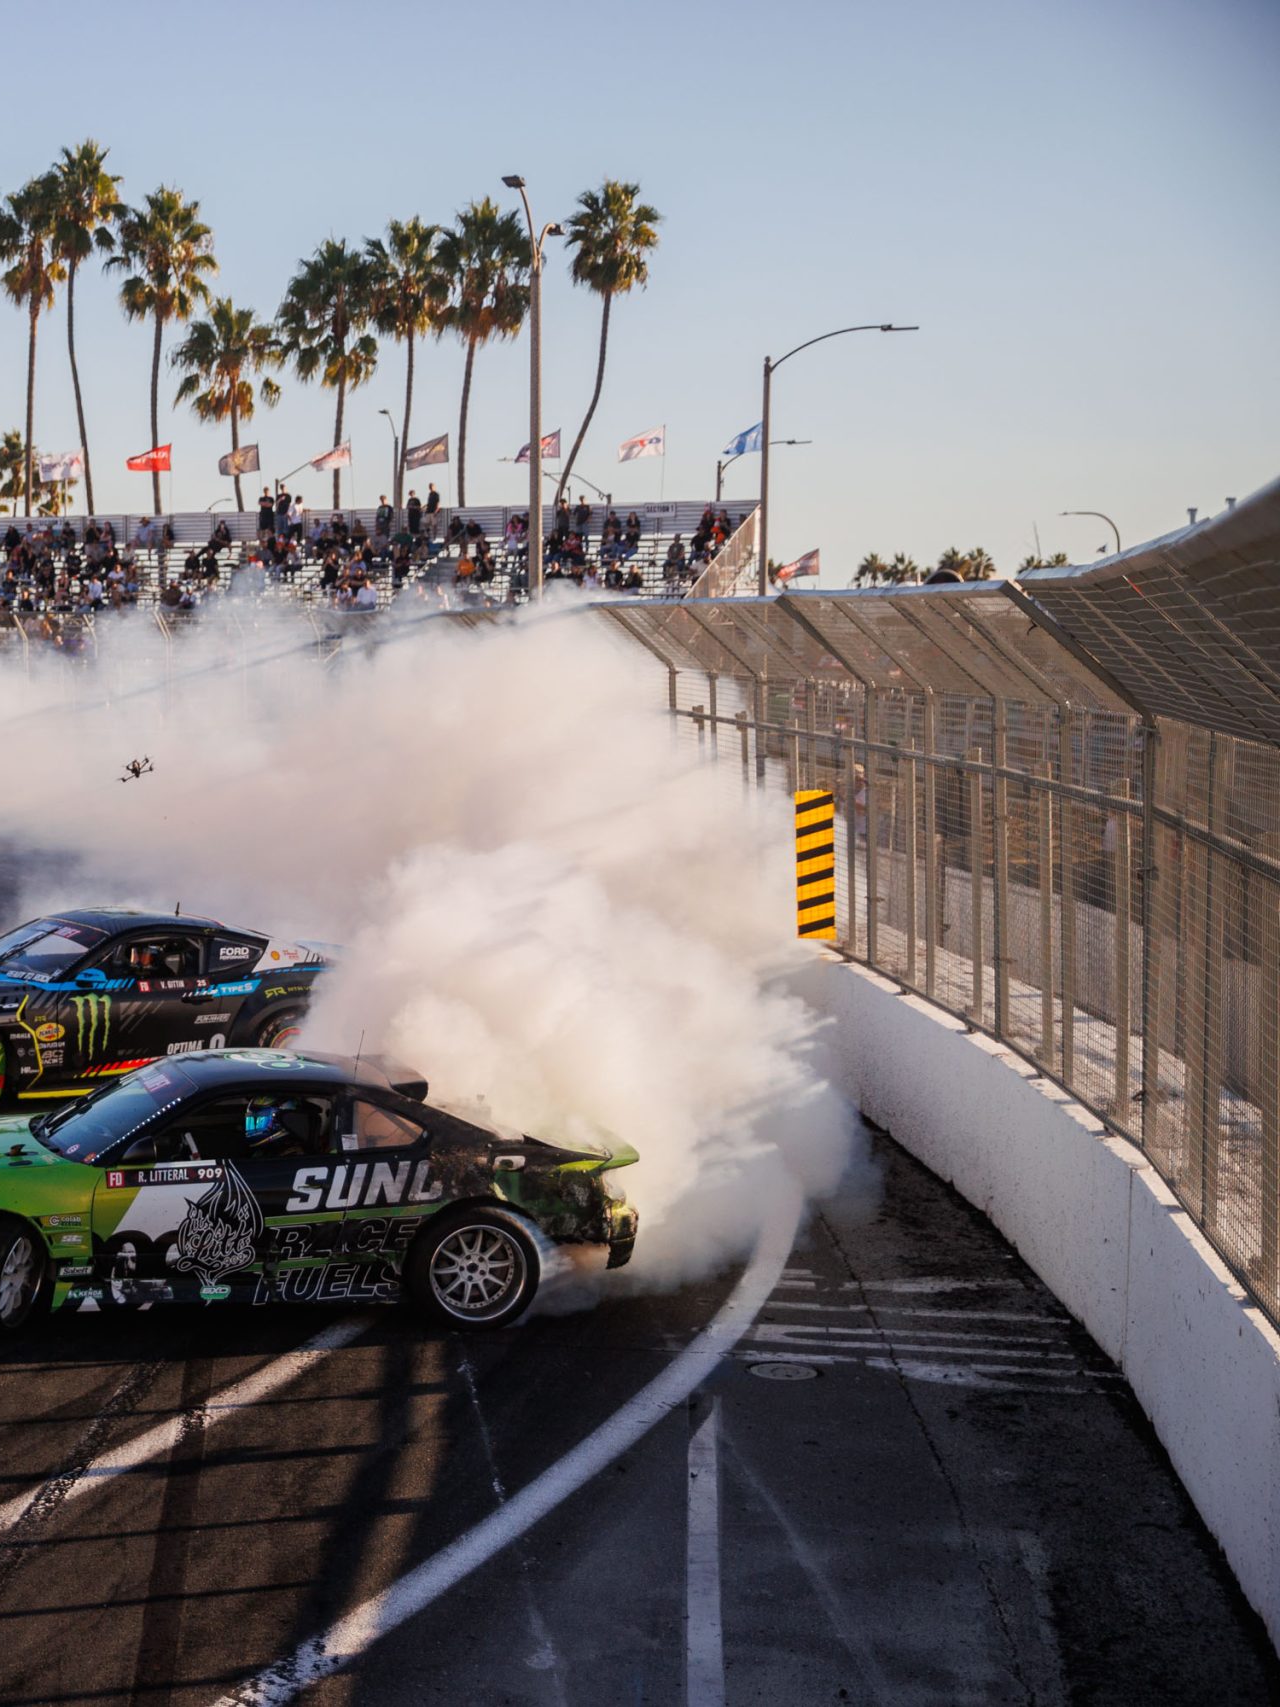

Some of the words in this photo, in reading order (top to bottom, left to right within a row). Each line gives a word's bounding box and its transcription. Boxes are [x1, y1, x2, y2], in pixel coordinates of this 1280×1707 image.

[646, 504, 669, 513] SECTION
[220, 947, 249, 956] FORD
[167, 1040, 203, 1056] OPTIMA
[109, 1172, 122, 1186] FD
[138, 1171, 147, 1182] R.
[149, 1169, 189, 1182] LITTERAL
[197, 1168, 222, 1179] 909
[63, 1267, 88, 1275] Sabelt
[79, 1288, 103, 1297] KENDA
